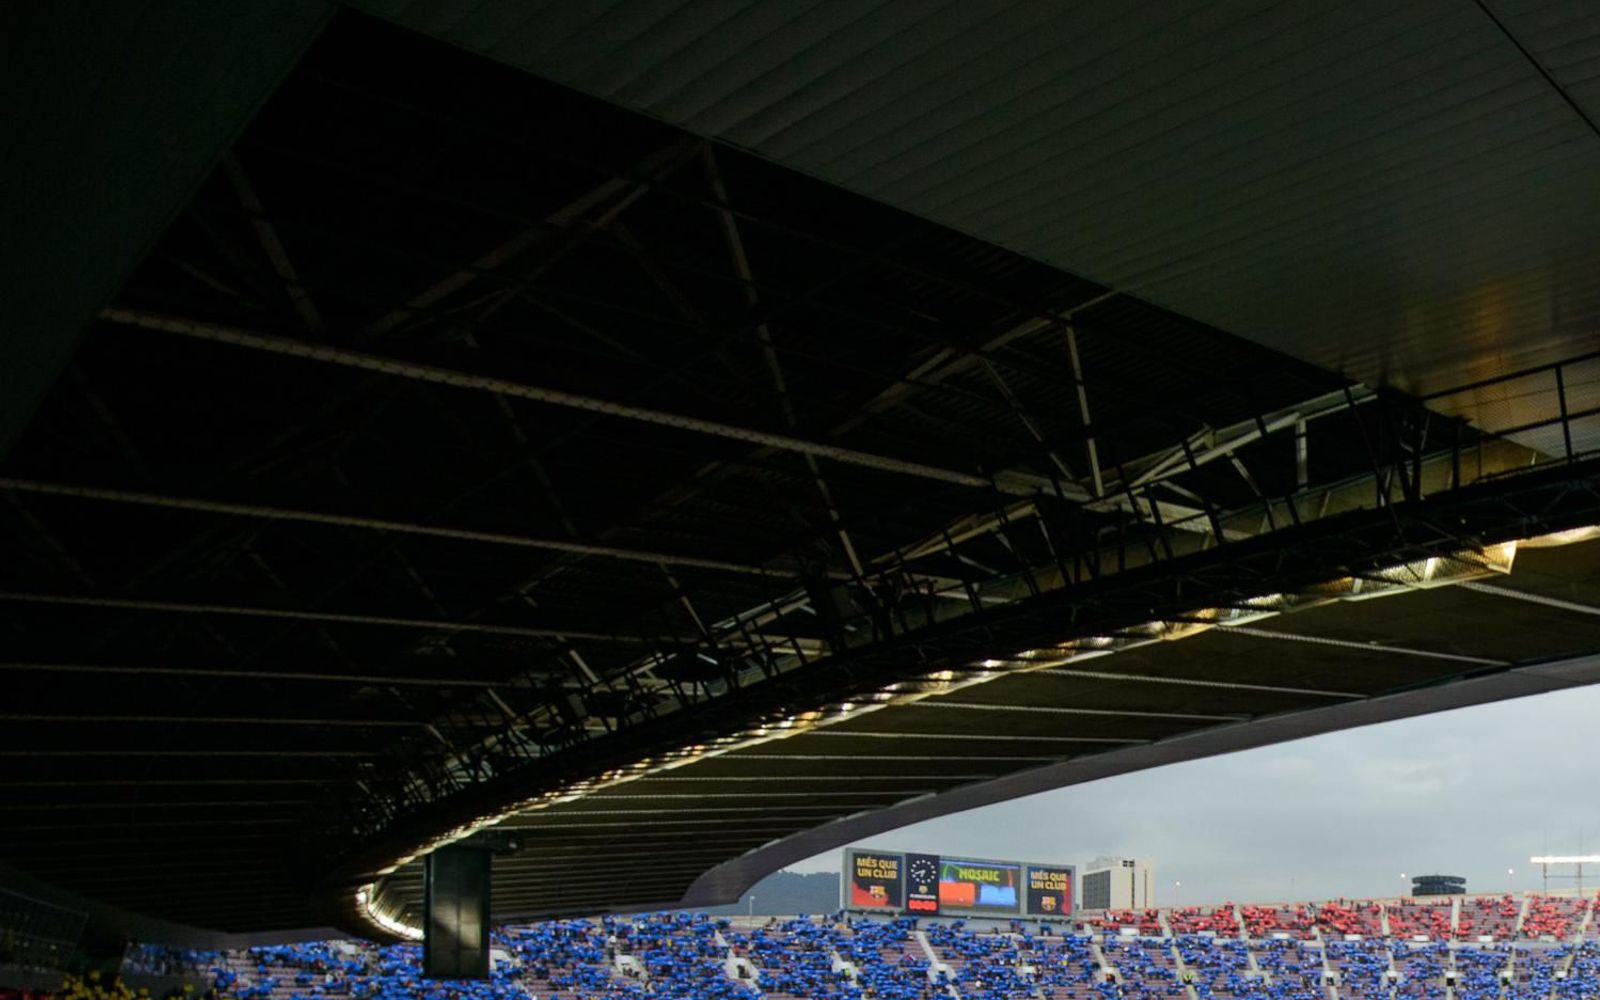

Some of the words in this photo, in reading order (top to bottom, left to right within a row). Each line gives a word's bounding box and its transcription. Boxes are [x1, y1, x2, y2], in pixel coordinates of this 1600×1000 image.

[857, 857, 877, 867] MÉS
[879, 860, 897, 869] QUE
[858, 868, 871, 877] UN
[873, 869, 897, 879] CLUB
[959, 868, 1000, 881] MOSAIC
[1050, 872, 1067, 881] QUE
[1031, 880, 1044, 889] UN
[1045, 881, 1066, 890] CLUB
